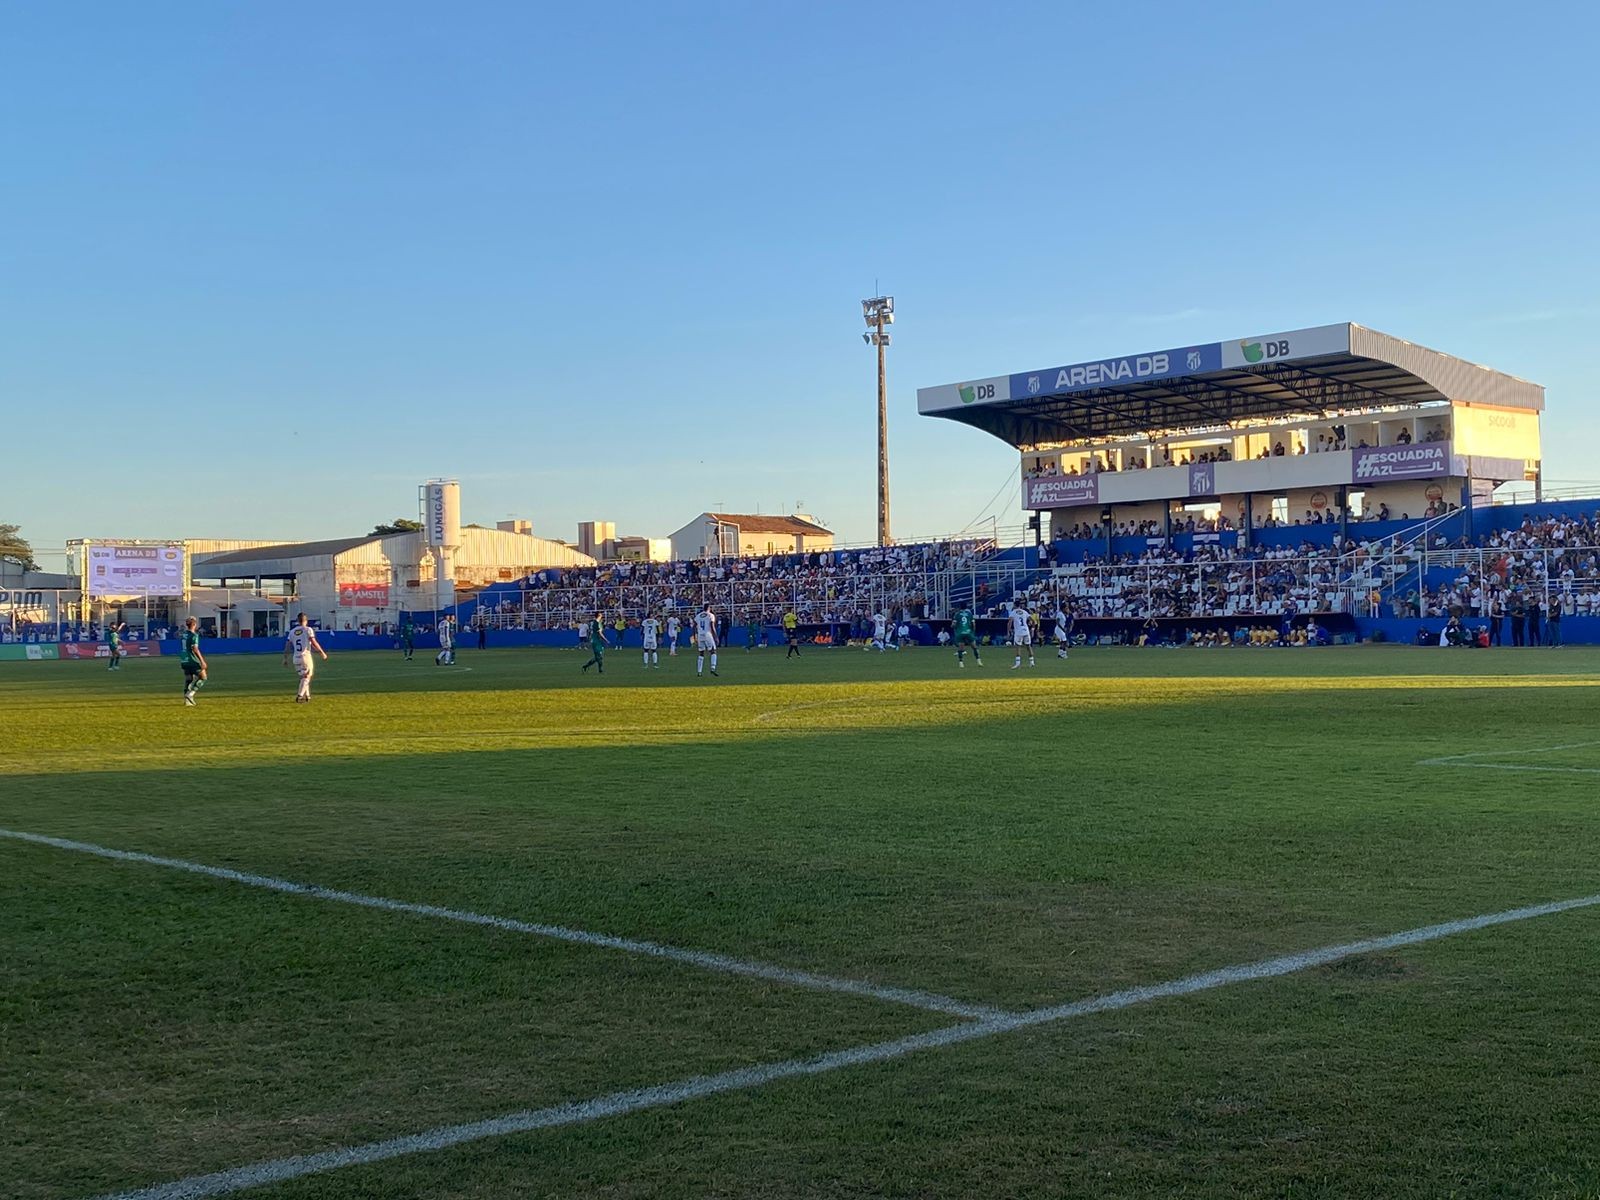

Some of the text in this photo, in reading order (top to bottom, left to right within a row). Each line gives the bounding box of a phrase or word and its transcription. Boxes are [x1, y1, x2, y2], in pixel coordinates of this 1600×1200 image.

[1265, 340, 1290, 358] DB
[1055, 354, 1169, 389] ARENA DB
[977, 384, 995, 400] DB
[1356, 448, 1443, 478] #ESQUADRA
[1031, 479, 1094, 503] #ESQUADRA
[355, 590, 386, 599] AMSTEL
[700, 620, 705, 631] 4
[961, 616, 968, 625] 9
[295, 638, 303, 652] 5
